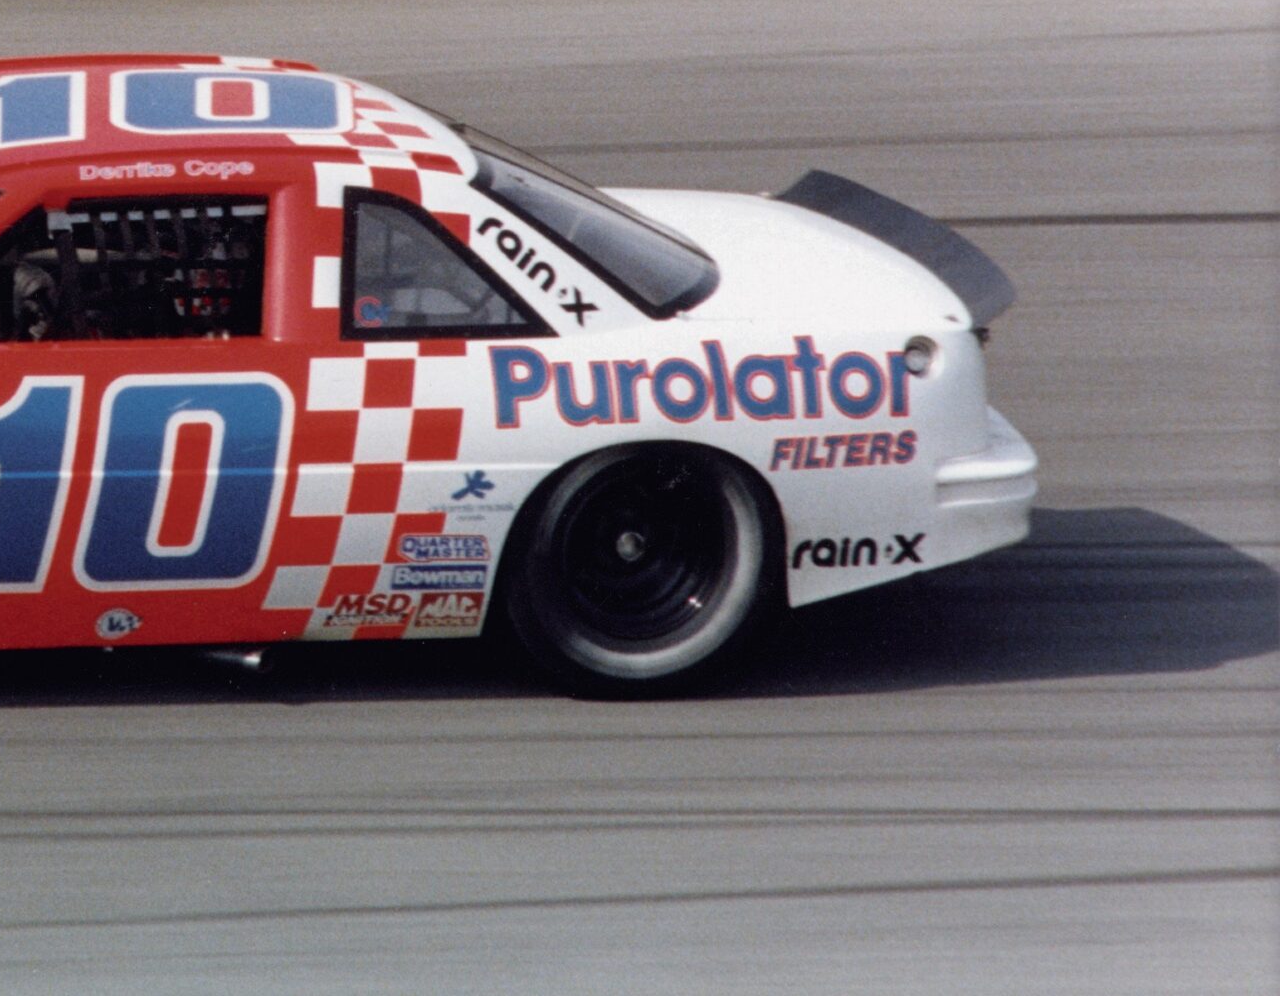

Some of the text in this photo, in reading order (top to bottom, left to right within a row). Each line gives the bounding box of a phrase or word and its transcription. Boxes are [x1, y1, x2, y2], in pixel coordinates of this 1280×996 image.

[80, 159, 255, 180] Derrike Cope
[488, 335, 914, 429] Purolator
[769, 430, 918, 472] FILTERS
[402, 537, 484, 553] QUARTER
[415, 547, 486, 559] MASTER
[394, 567, 484, 585] Bowman
[334, 593, 413, 615] MSD
[420, 593, 480, 617] MAC
